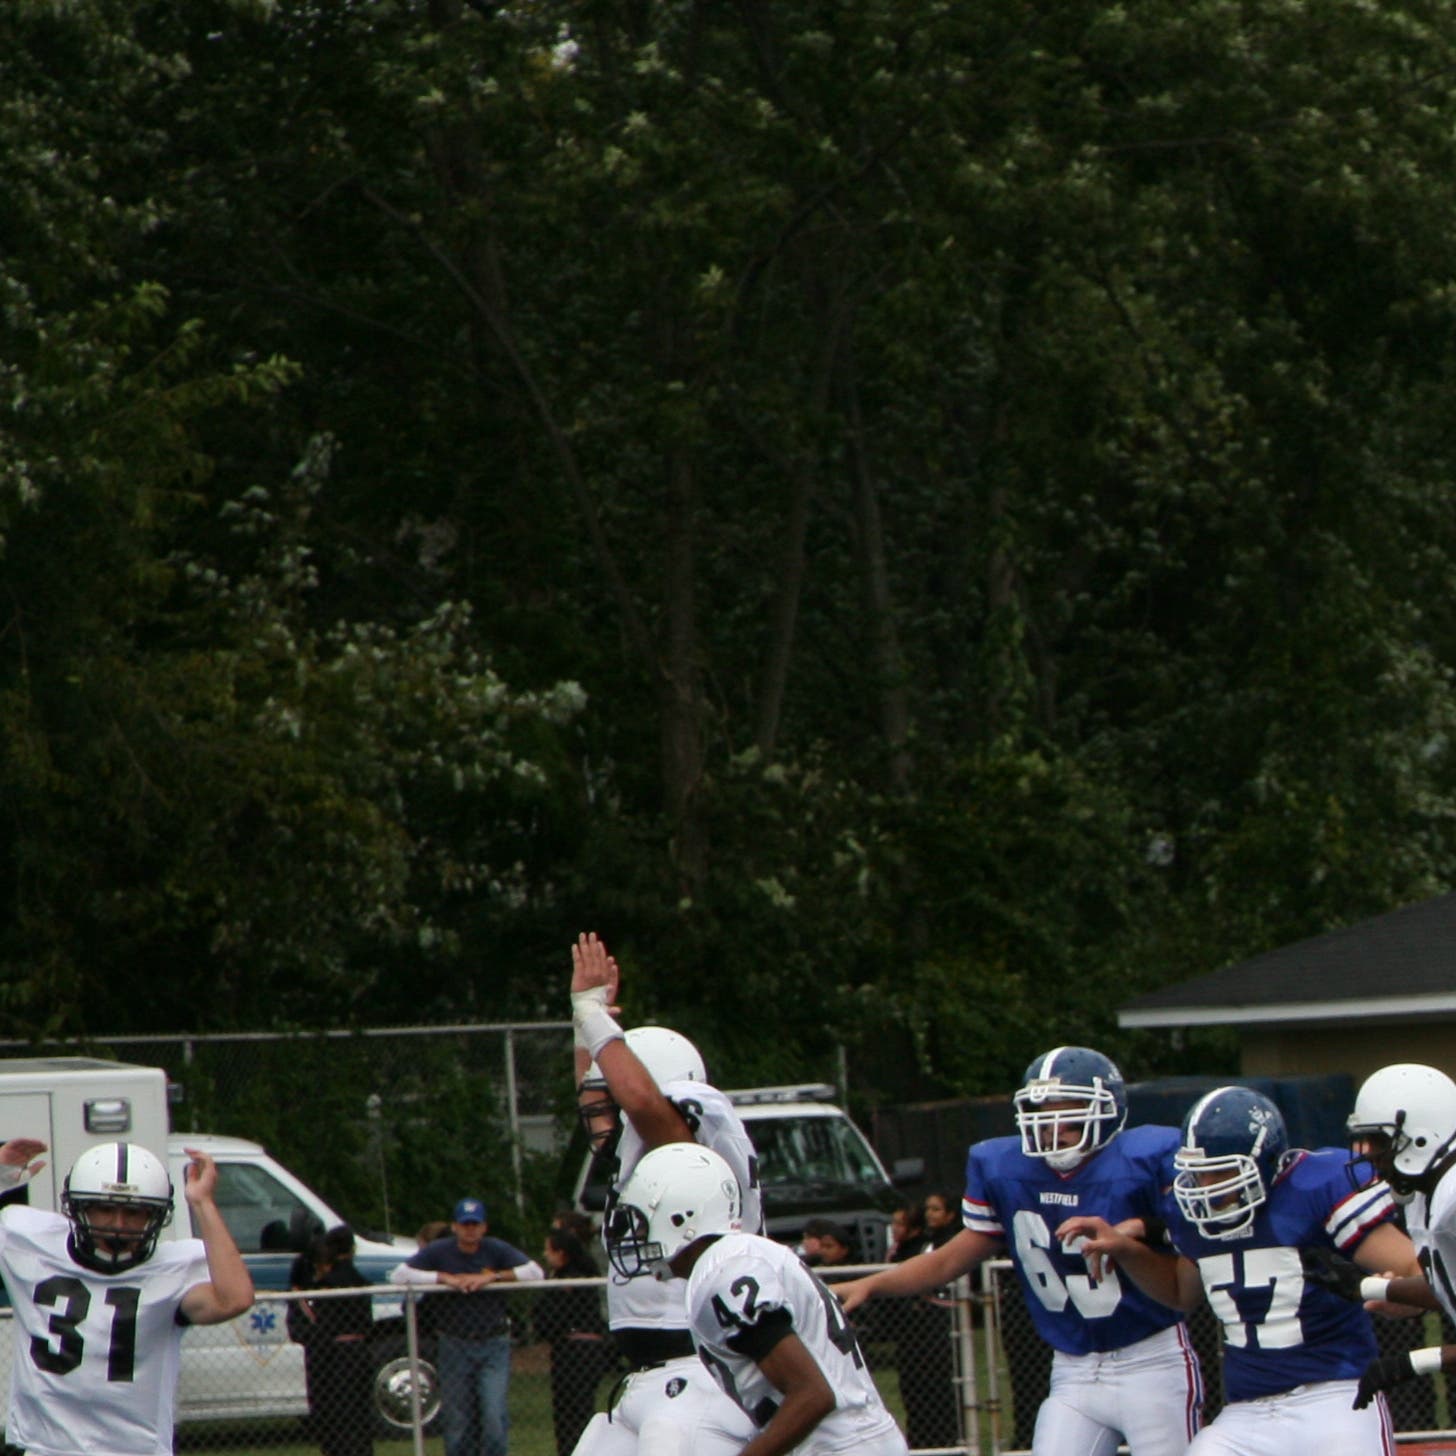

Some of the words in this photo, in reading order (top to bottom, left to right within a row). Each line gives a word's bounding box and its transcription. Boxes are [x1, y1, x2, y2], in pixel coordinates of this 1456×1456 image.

[1039, 1192, 1079, 1207] WESTFIELD
[710, 1275, 768, 1328] 42
[1013, 1210, 1122, 1319] 63
[1197, 1247, 1305, 1349] 57
[30, 1275, 141, 1382] 31
